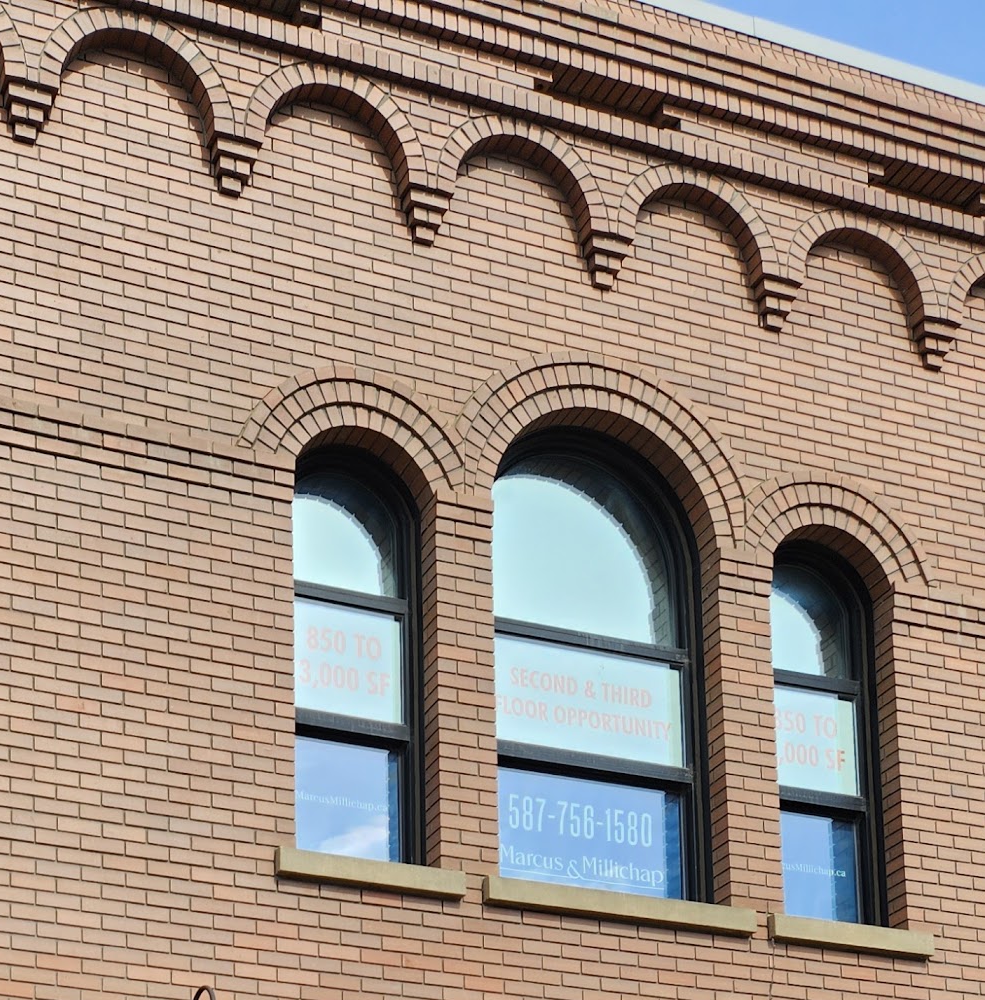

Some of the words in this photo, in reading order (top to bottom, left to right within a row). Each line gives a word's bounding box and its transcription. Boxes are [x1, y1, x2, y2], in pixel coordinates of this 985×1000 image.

[306, 626, 346, 656] 850
[354, 633, 382, 660] TO
[299, 659, 359, 692] 3,000
[367, 671, 390, 697] SF
[510, 667, 578, 696] SECOND
[584, 680, 596, 699] &
[601, 682, 653, 709] THIRD
[553, 705, 672, 741] OPPORTUNITY
[814, 714, 838, 739] TO
[778, 742, 819, 768] ,000
[825, 748, 846, 772] SF
[509, 793, 653, 847] 587-756-1580
[499, 843, 564, 871] Marcus
[566, 860, 581, 879] &
[582, 855, 664, 887] Millichap
